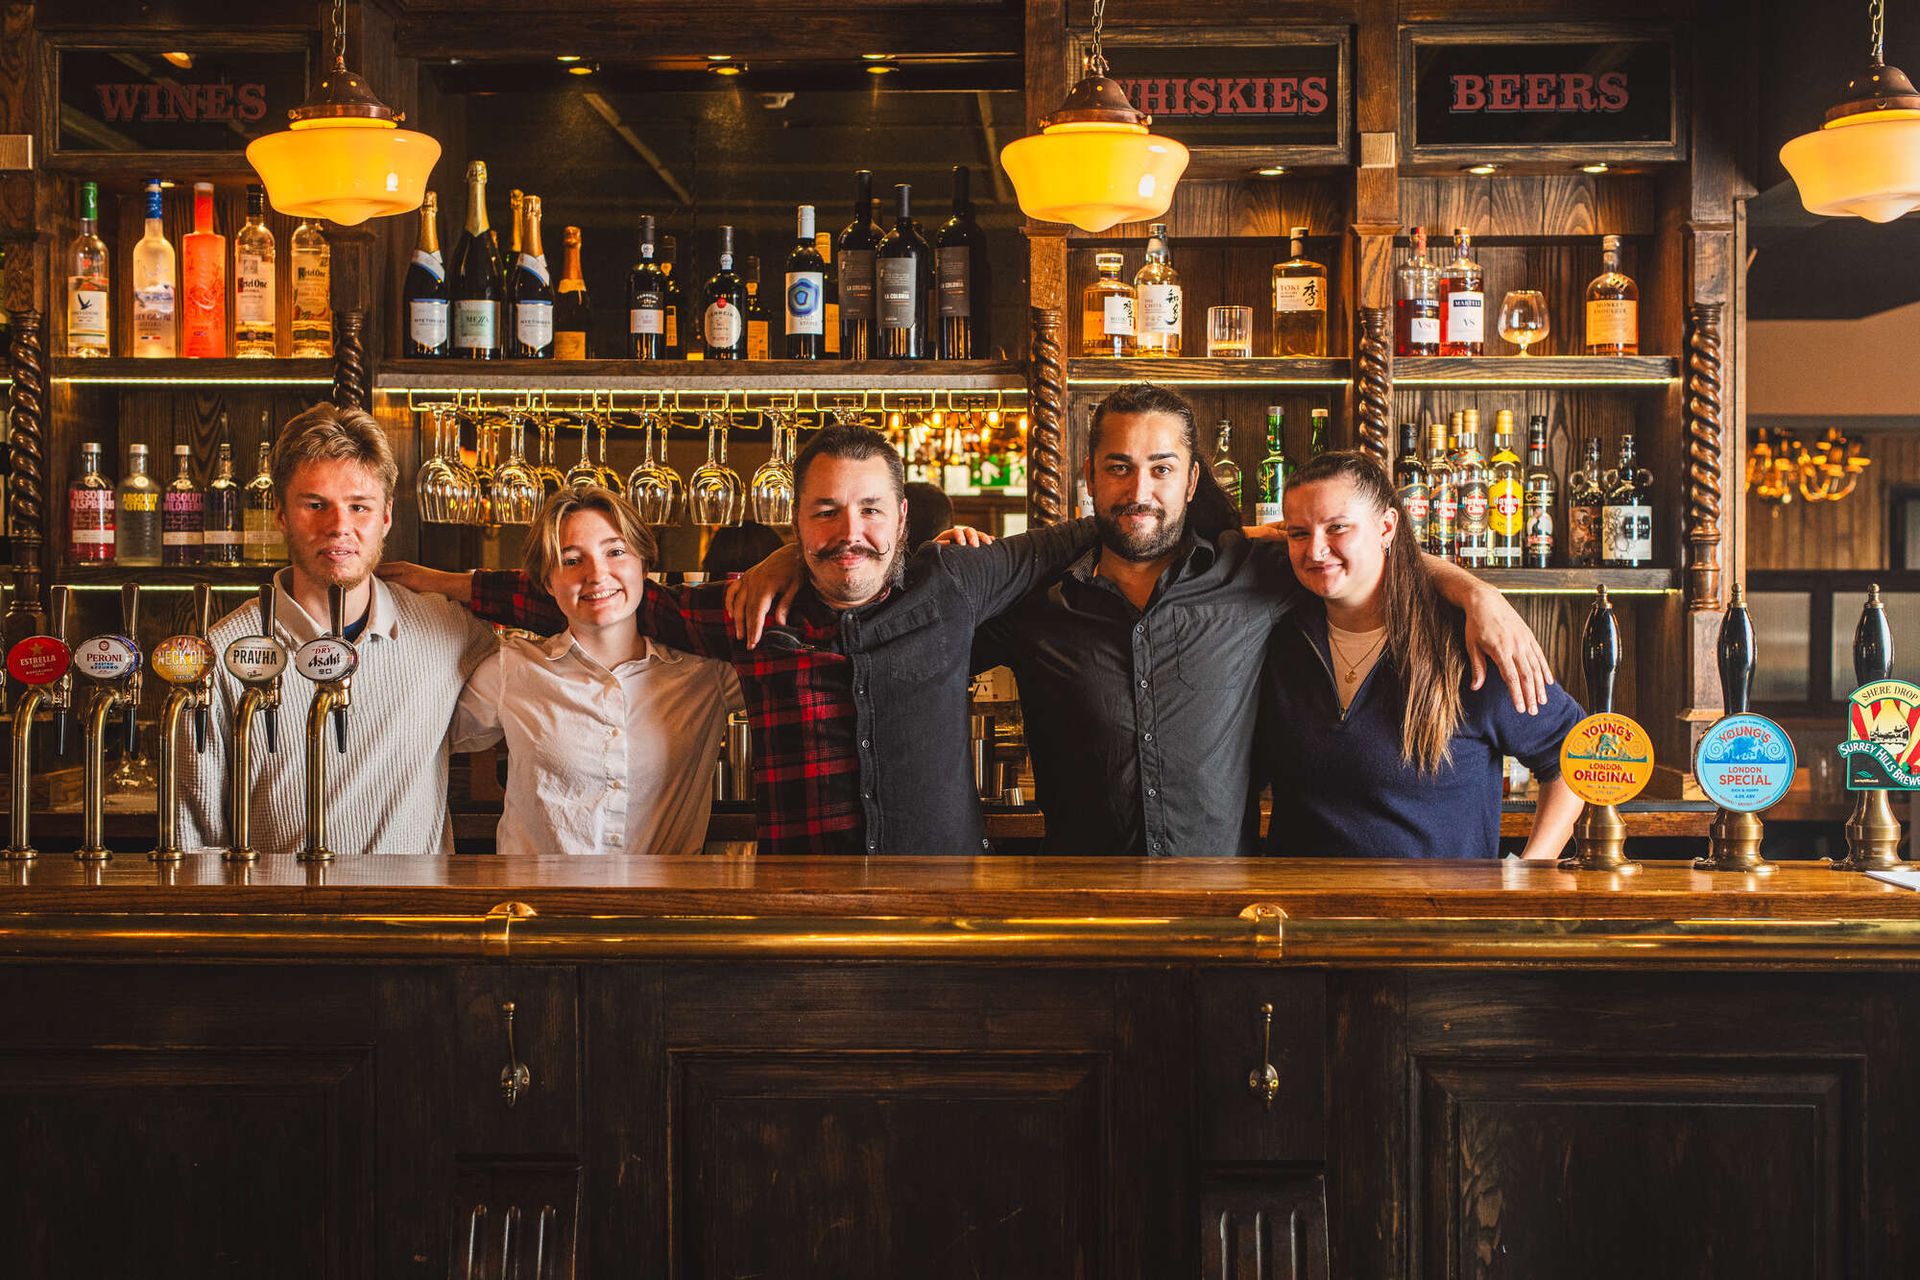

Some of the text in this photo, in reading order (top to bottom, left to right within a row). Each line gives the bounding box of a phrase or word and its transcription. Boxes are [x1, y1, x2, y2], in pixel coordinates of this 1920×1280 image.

[1450, 72, 1629, 113] BEERS
[97, 83, 267, 122] WINES
[74, 490, 112, 500] ABSOLUT
[123, 493, 158, 503] ABSOLUT
[166, 492, 202, 502] ABSOLUT
[125, 502, 156, 512] CITRON
[20, 654, 56, 666] ESTRELLA
[87, 653, 122, 662] PERONI
[158, 649, 208, 665] NECK OIL
[233, 650, 277, 665] PRAVHA
[308, 653, 340, 668] Asahi
[1862, 686, 1919, 702] SHERE DROP
[1582, 723, 1634, 741] YOUNG'S
[1719, 726, 1771, 744] YOUNG'S
[1840, 743, 1877, 755] SURREY
[1875, 748, 1896, 772] HILLS
[1590, 763, 1623, 771] LONDON
[1574, 769, 1636, 784] ORIGINAL
[1719, 775, 1772, 785] SPECIAL
